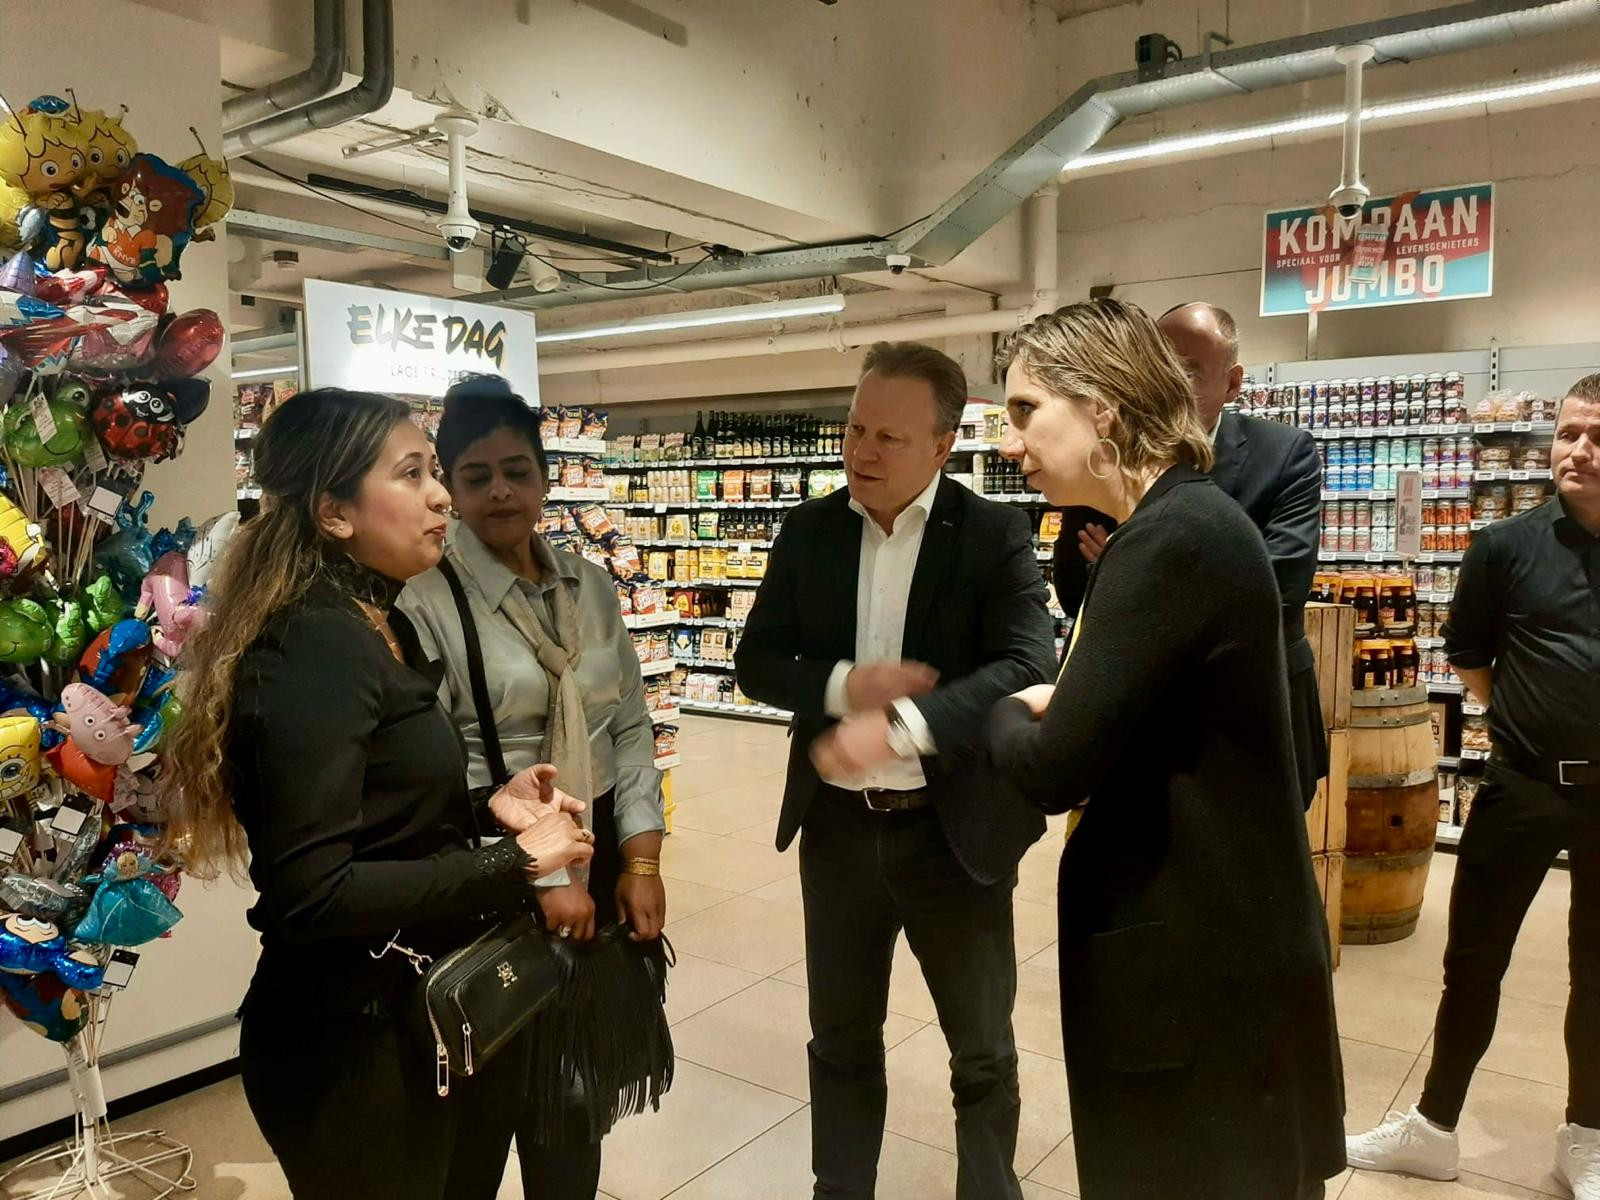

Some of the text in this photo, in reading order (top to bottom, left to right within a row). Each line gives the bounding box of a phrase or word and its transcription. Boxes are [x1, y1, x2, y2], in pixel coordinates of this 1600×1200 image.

[1276, 255, 1316, 269] SPECIAAL
[1319, 253, 1341, 264] VOOR
[1396, 238, 1479, 255] LEVENSGENIETERS
[1305, 254, 1445, 305] JUMBO
[347, 303, 507, 369] ELKE DAG
